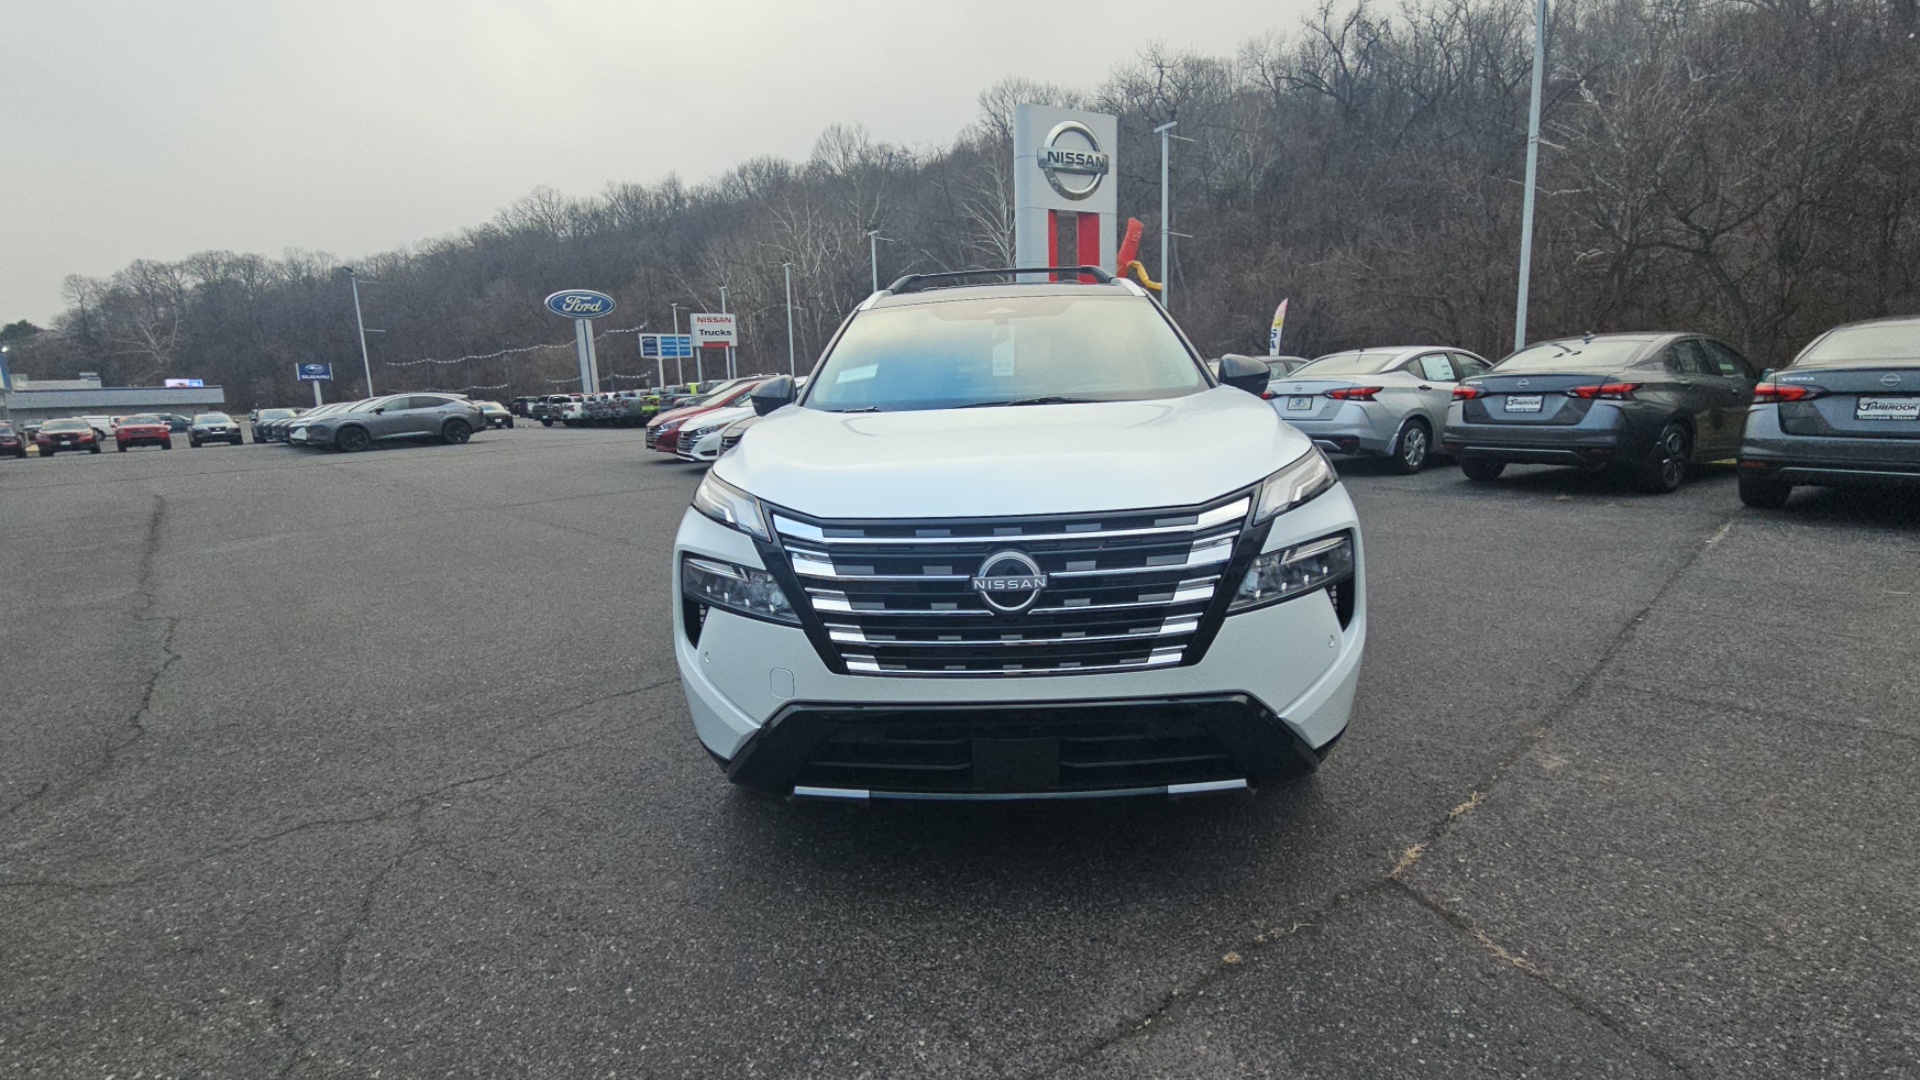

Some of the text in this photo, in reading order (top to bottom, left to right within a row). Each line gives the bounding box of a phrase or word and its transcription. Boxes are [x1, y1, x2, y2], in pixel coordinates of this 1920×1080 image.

[1047, 151, 1104, 168] NISSAN
[562, 295, 602, 312] Ford
[973, 578, 1046, 590] NISSAN
